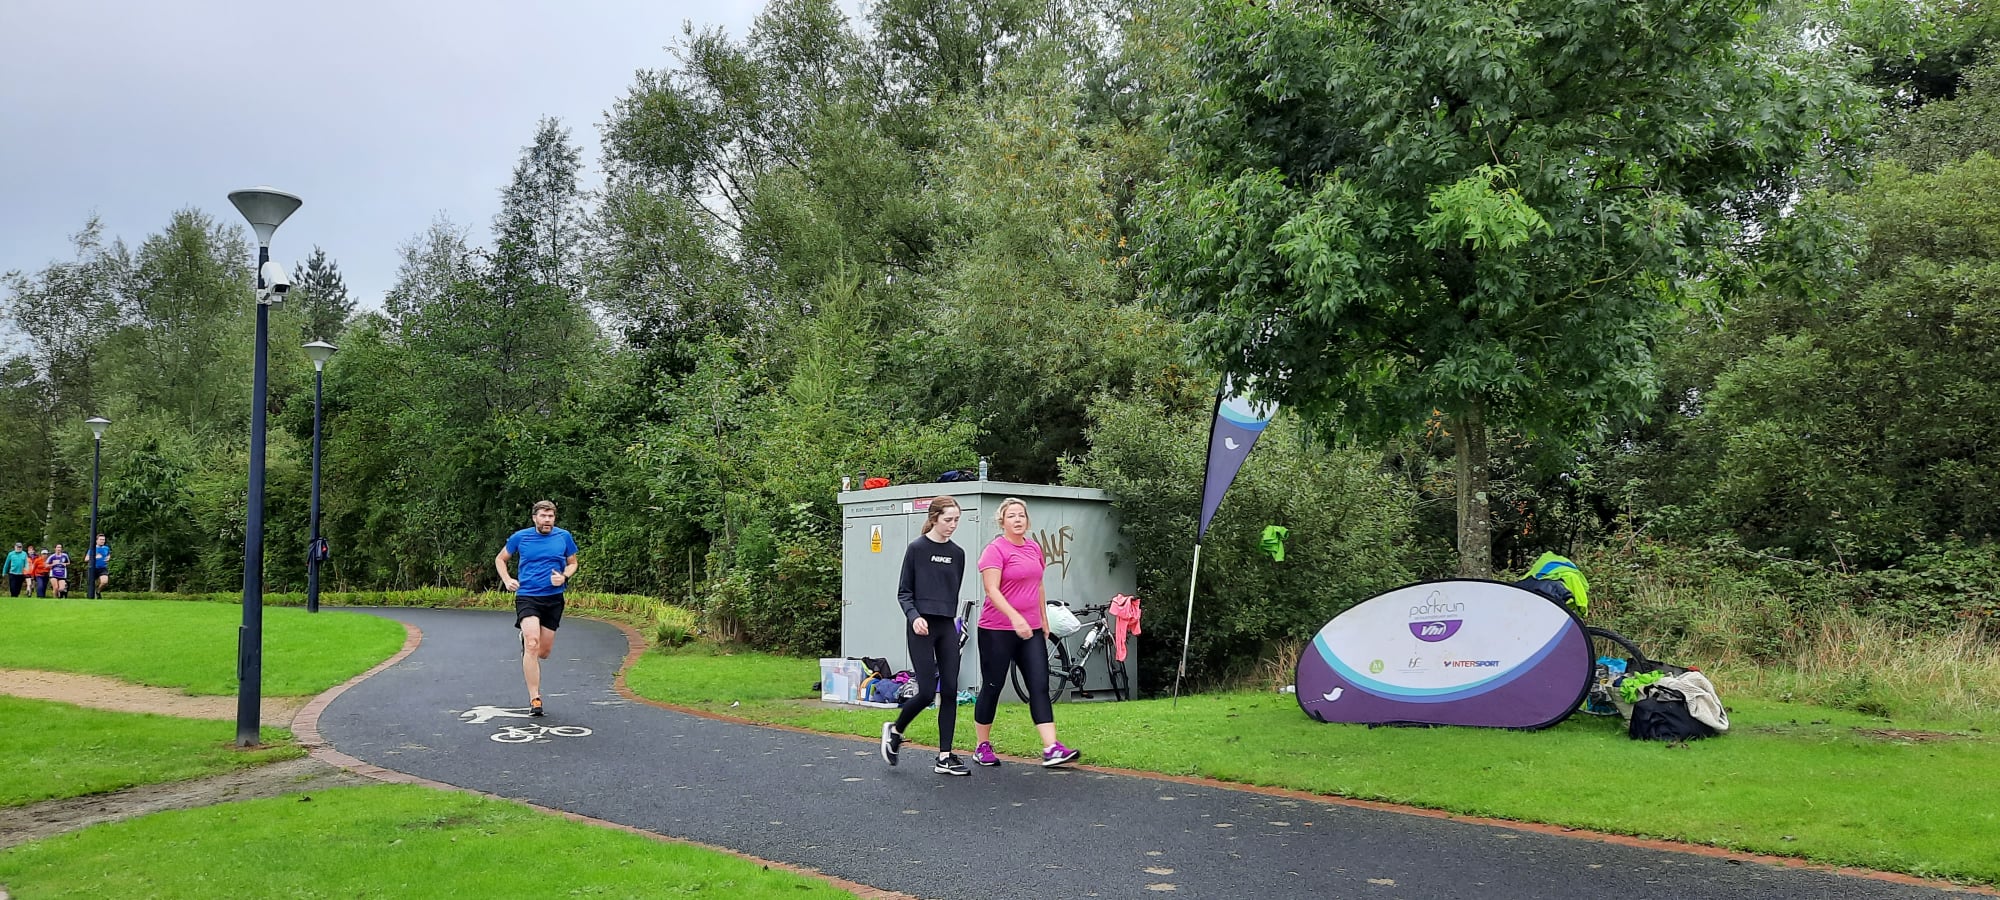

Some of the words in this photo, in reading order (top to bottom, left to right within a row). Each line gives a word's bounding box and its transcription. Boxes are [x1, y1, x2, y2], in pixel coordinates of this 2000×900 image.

[931, 555, 952, 563] NIKE
[1409, 597, 1464, 617] parkrun
[1452, 660, 1499, 668] INTERSPORT
